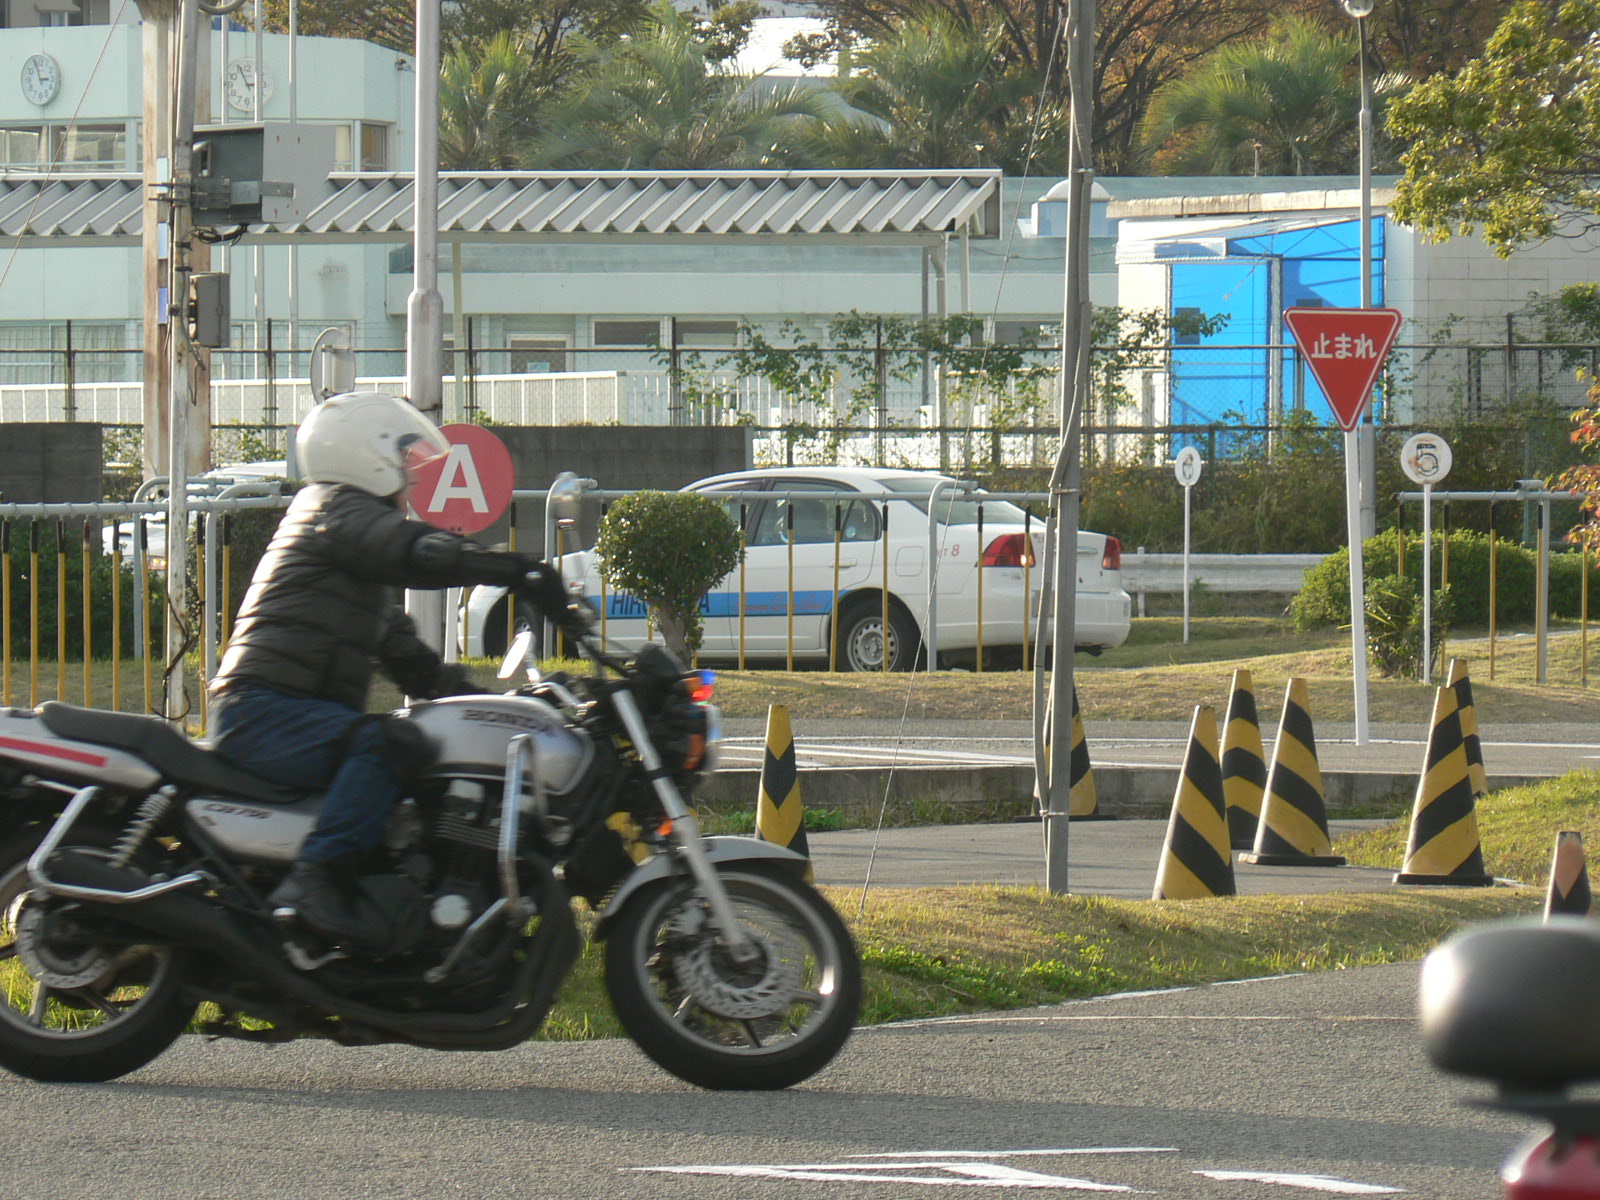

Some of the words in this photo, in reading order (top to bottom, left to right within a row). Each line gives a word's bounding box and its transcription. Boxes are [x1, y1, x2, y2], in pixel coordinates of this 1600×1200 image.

[243, 64, 252, 72] 12
[244, 97, 250, 105] 6
[1311, 332, 1377, 360] 止まれ
[1416, 443, 1439, 477] 5
[427, 443, 489, 513] A
[951, 543, 960, 557] 8
